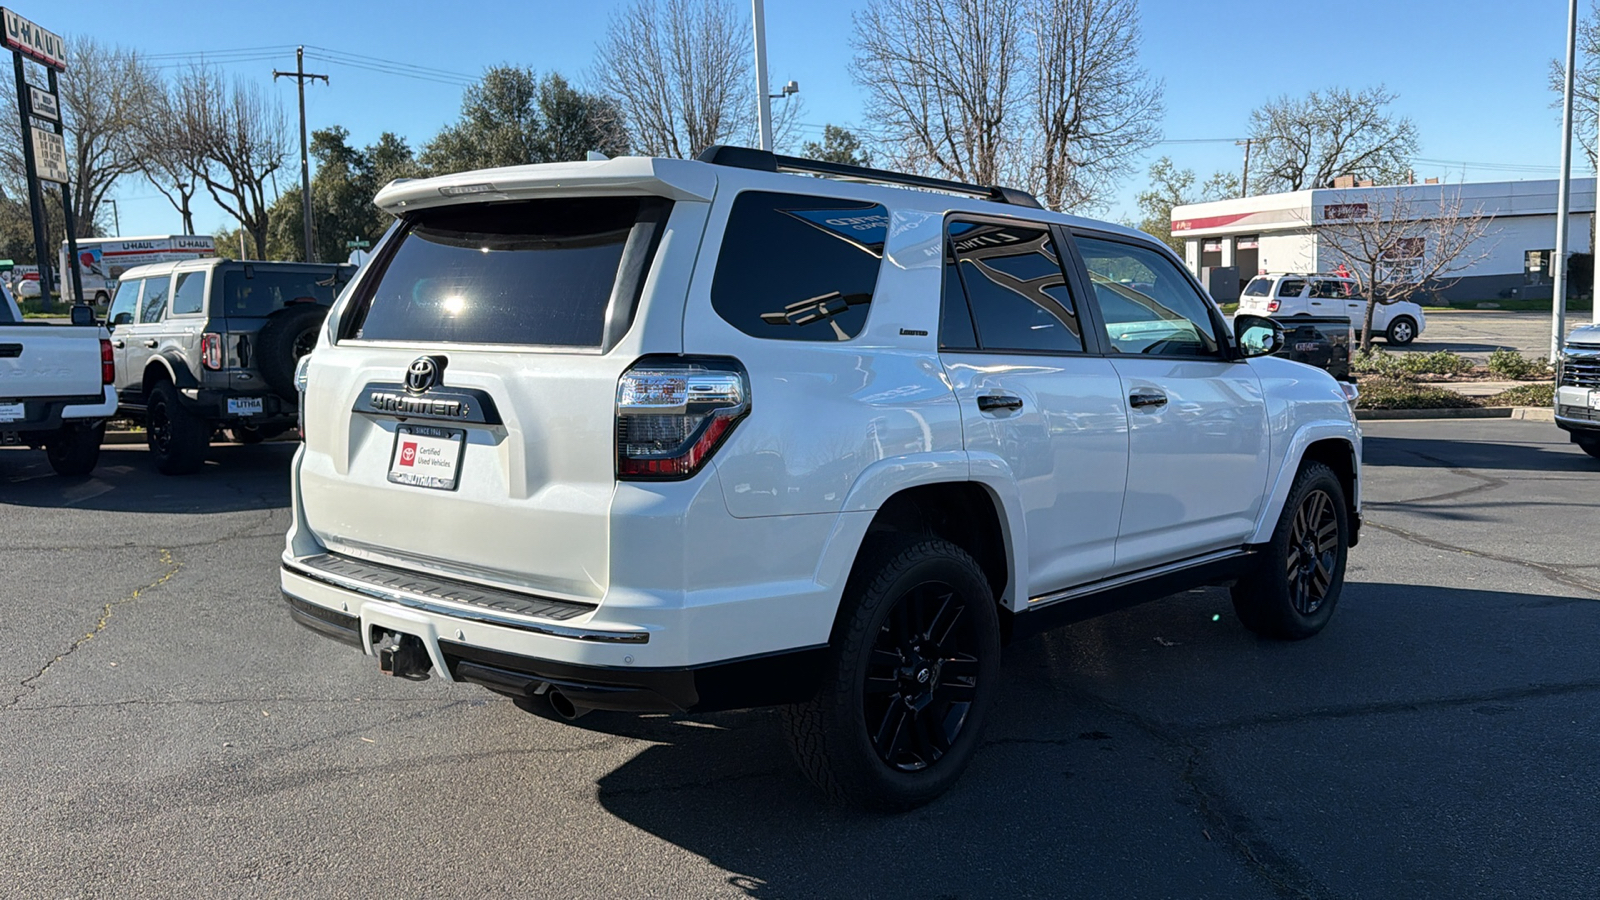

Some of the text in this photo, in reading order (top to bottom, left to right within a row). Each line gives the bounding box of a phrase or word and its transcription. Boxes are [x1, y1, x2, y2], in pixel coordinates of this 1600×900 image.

[123, 242, 154, 250] U-HAUL
[179, 240, 210, 248] U-HAUL
[236, 400, 261, 408] LITHIA
[415, 427, 430, 436] SINCE
[419, 446, 441, 457] Certified
[417, 457, 451, 469] Used Vehicles
